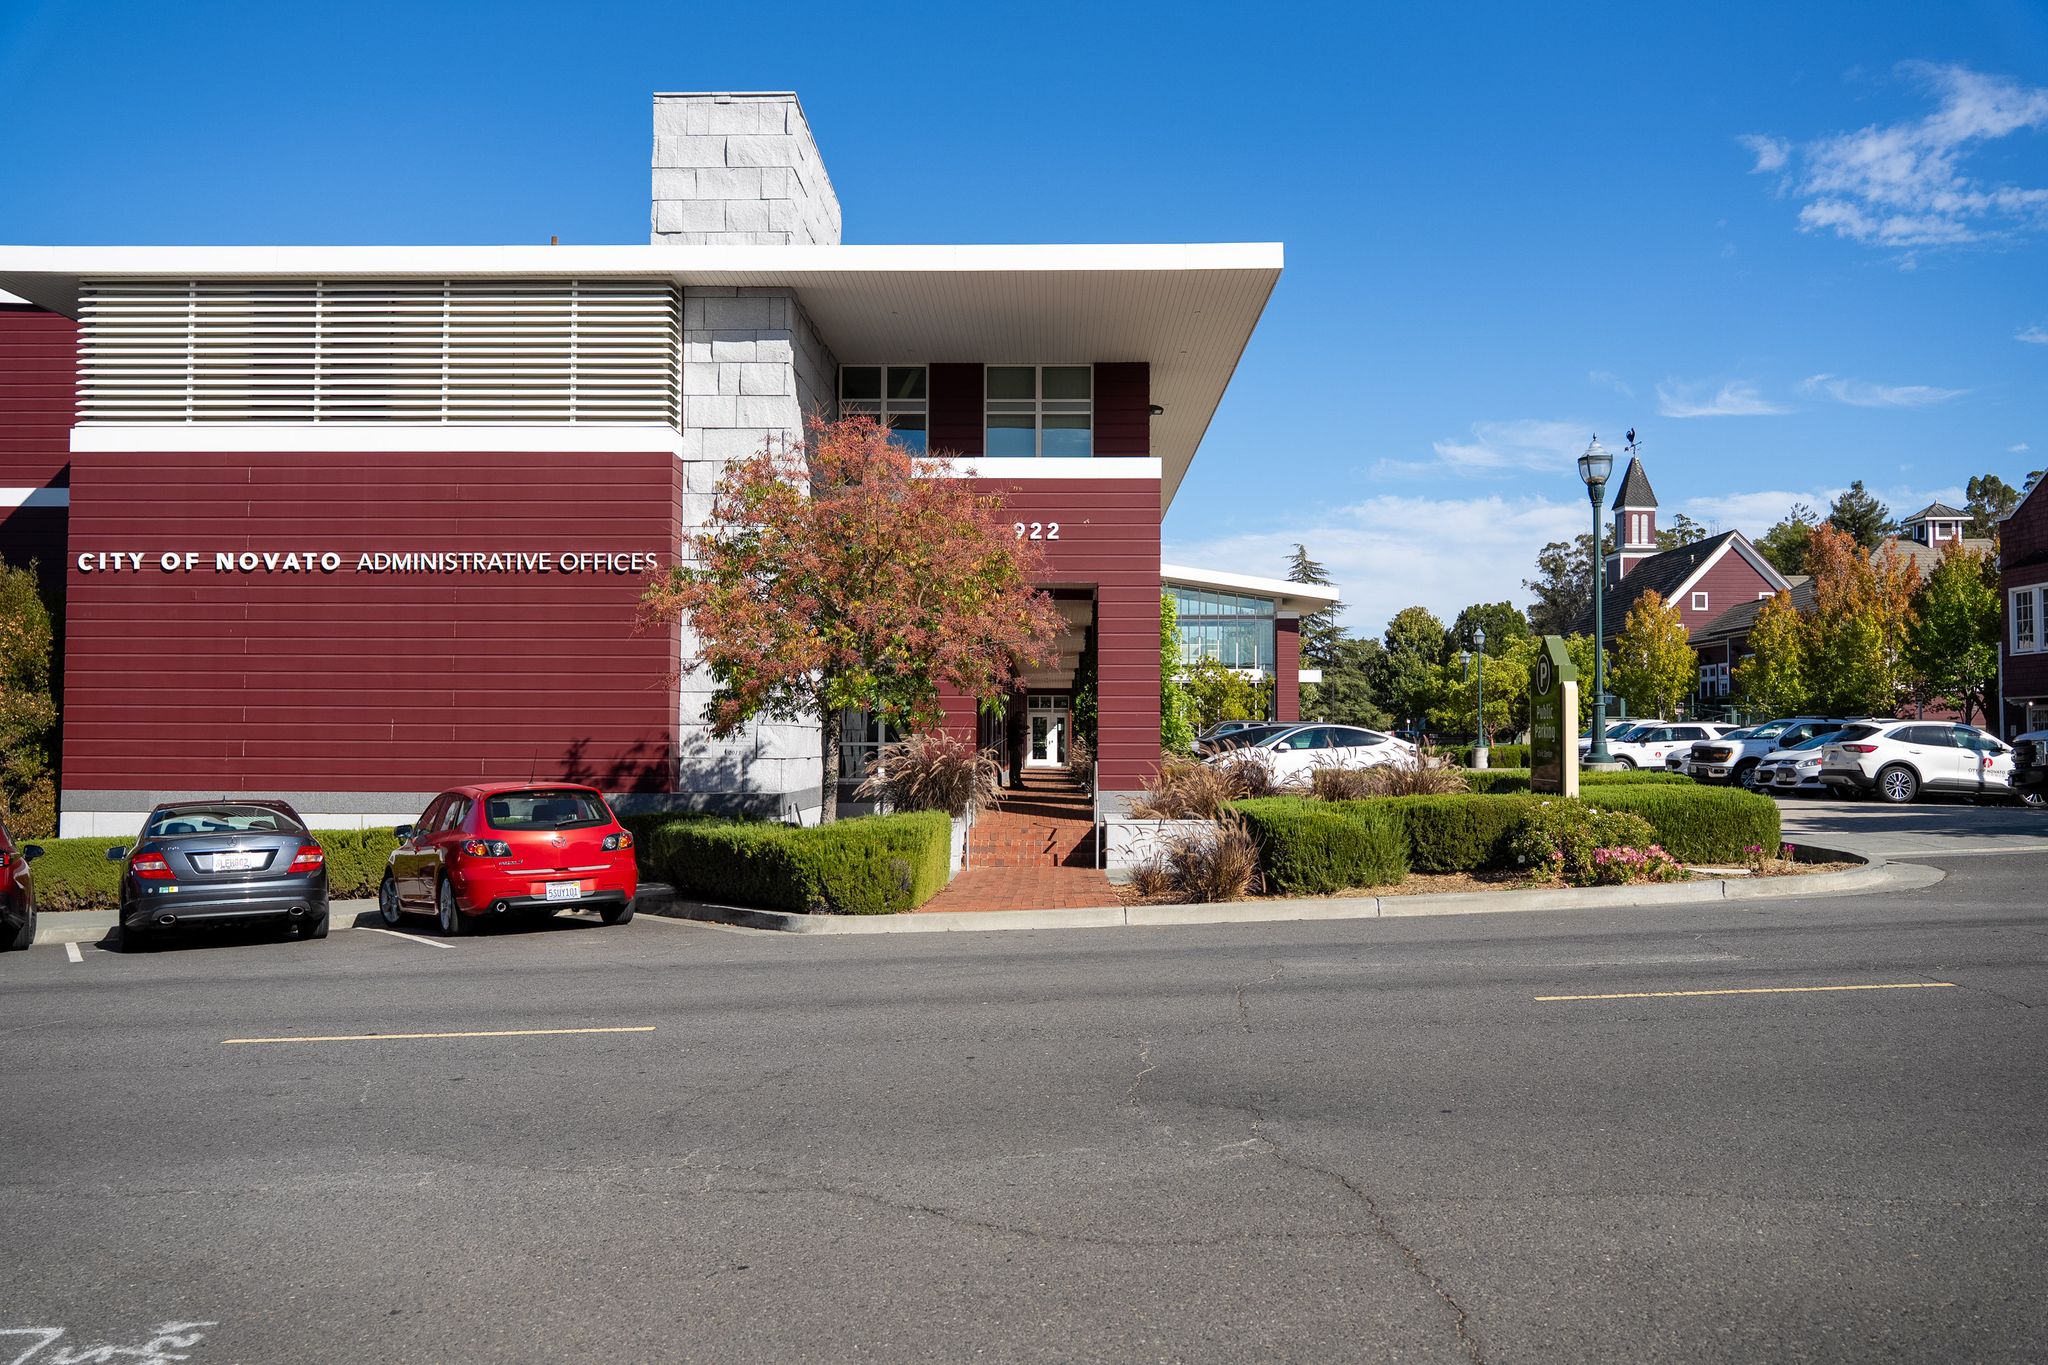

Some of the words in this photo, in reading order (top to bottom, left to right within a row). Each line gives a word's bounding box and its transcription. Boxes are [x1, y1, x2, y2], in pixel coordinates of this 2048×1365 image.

[1013, 522, 1060, 540] 922
[77, 552, 145, 571] CITY
[160, 552, 199, 571] OF
[215, 552, 341, 571] NOVATO
[357, 552, 551, 571] ADMINISTRATIVE
[559, 552, 658, 571] OFFICES
[1540, 662, 1547, 688] P
[1536, 704, 1553, 719] Public
[1534, 723, 1555, 743] Parking
